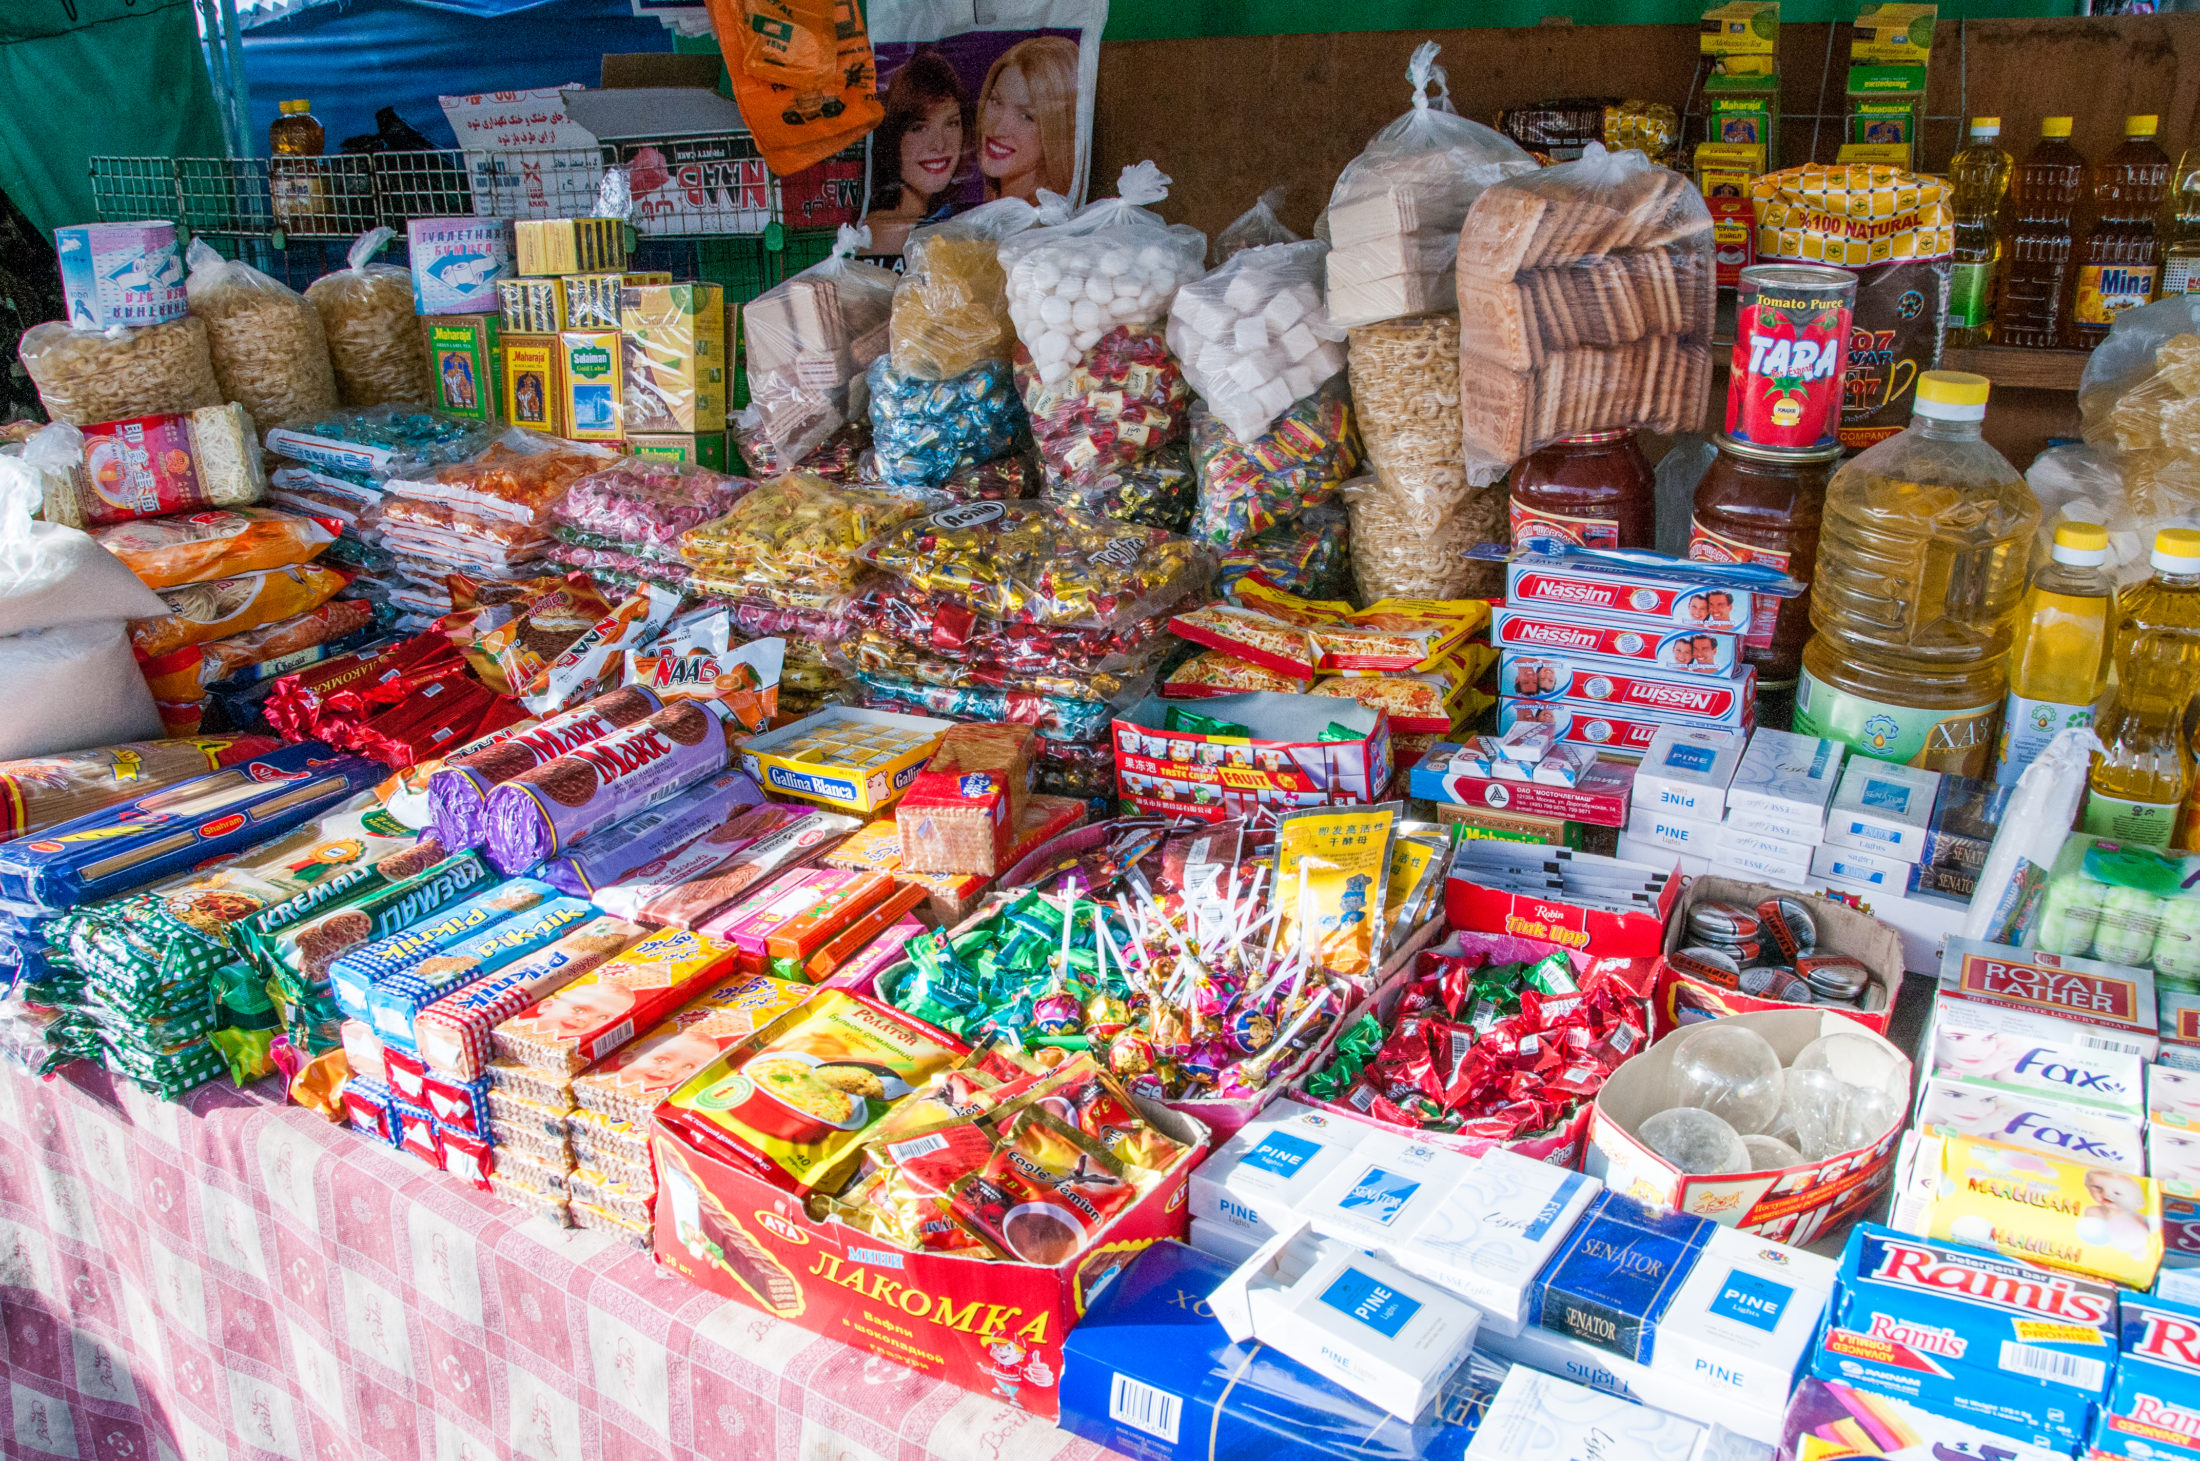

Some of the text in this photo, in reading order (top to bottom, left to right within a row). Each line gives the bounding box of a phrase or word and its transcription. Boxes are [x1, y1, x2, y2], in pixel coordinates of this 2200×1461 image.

[1719, 100, 1762, 111] Maharaja
[679, 161, 769, 211] NAAB
[421, 228, 501, 244] ТУАЛЕТНАЯ
[1845, 213, 1923, 239] NATURAL
[434, 241, 492, 256] БУМАГА
[2100, 268, 2151, 294] Mina
[1757, 294, 1844, 310] Tomato Puree
[432, 327, 472, 342] Maharaja
[512, 350, 546, 363] Maharaja
[573, 352, 607, 365] Sulaiman
[1748, 334, 1839, 383] TARA
[1840, 431, 1890, 442] COMPANY
[124, 423, 161, 513] 即食蛋面
[943, 503, 999, 528] Achin
[1089, 536, 1147, 566] Toffee
[1536, 581, 1613, 604] Nassim
[557, 616, 619, 671] NAAB
[1520, 624, 1597, 648] Nassim
[653, 656, 722, 688] NAAB
[1631, 685, 1712, 709] Nassim
[514, 714, 607, 763] Marie
[572, 728, 671, 785] Marie
[1124, 756, 1157, 774] 果冻泡
[1671, 752, 1709, 765] PINE
[772, 770, 854, 800] Gallina Blanca
[1160, 767, 1187, 779] TASTE
[1187, 770, 1219, 782] CANDY
[1224, 770, 1266, 787] FRUIT
[1534, 789, 1594, 802] "МОСТОЧЛЕГМАШ"
[1660, 791, 1695, 808] PINE
[202, 817, 243, 836] Shahram
[1318, 823, 1384, 836] 即发高活性
[1655, 824, 1689, 841] PINE
[1329, 836, 1368, 847] 干酵母
[257, 865, 373, 935] KREMALI
[378, 856, 487, 939] KREMALI
[1535, 905, 1564, 923] Robin
[377, 907, 490, 962] Piknik
[477, 905, 586, 958] Piknik
[1506, 916, 1590, 948] Tink Upp
[456, 951, 570, 1010] Piknik
[1986, 960, 2114, 998] ROYAL
[1983, 978, 2113, 1014] LATHER
[1966, 994, 2130, 1031] THE ULTIMATE LUXURY SOAP
[828, 1012, 916, 1063] Бульон домашний
[852, 1008, 918, 1048] РОЛЛТОН
[2014, 1047, 2112, 1092] Fax
[2005, 1112, 2109, 1158] Fax
[797, 1152, 812, 1168] 40
[1007, 1150, 1051, 1181] Eagle
[1258, 1144, 1303, 1166] PINE
[1262, 1155, 1284, 1169] Lights
[1353, 1184, 1403, 1208] SENATOR
[1969, 1177, 2081, 1217] МАЛЫШАМ
[1219, 1198, 1259, 1224] PINE
[1228, 1214, 1251, 1230] Lights
[1534, 1199, 1562, 1225] ESSE
[764, 1215, 800, 1242] АТА
[847, 1245, 905, 1270] МИНИ
[1580, 1236, 1665, 1279] SENATOR
[1990, 1226, 2083, 1263] МАЛЫШАМ
[664, 1253, 697, 1278] 36 шт.
[1945, 1252, 2050, 1283] Detergent bar
[808, 1250, 1051, 1346] ЛАКОМКА
[1872, 1244, 2114, 1327] Ramis
[1355, 1285, 1393, 1321] PINE
[1379, 1302, 1399, 1322] Lights
[1723, 1287, 1780, 1316] PINE
[1731, 1302, 1761, 1320] Lights
[863, 1310, 914, 1340] Вафли
[1564, 1306, 1617, 1342] SENATOR
[1868, 1311, 1968, 1360] Ramis
[2020, 1330, 2098, 1343] PROMISE
[855, 1320, 946, 1367] шоколадной
[1832, 1341, 1896, 1364] ADVANCED
[1836, 1332, 1894, 1353] FORMULA
[868, 1342, 930, 1372] глазури
[1321, 1345, 1350, 1369] PINE
[1565, 1359, 1630, 1395] Lights
[1694, 1358, 1745, 1388] PINE
[1864, 1367, 1922, 1388] PAKNAM
[2116, 1418, 2192, 1446] ADVANCED
